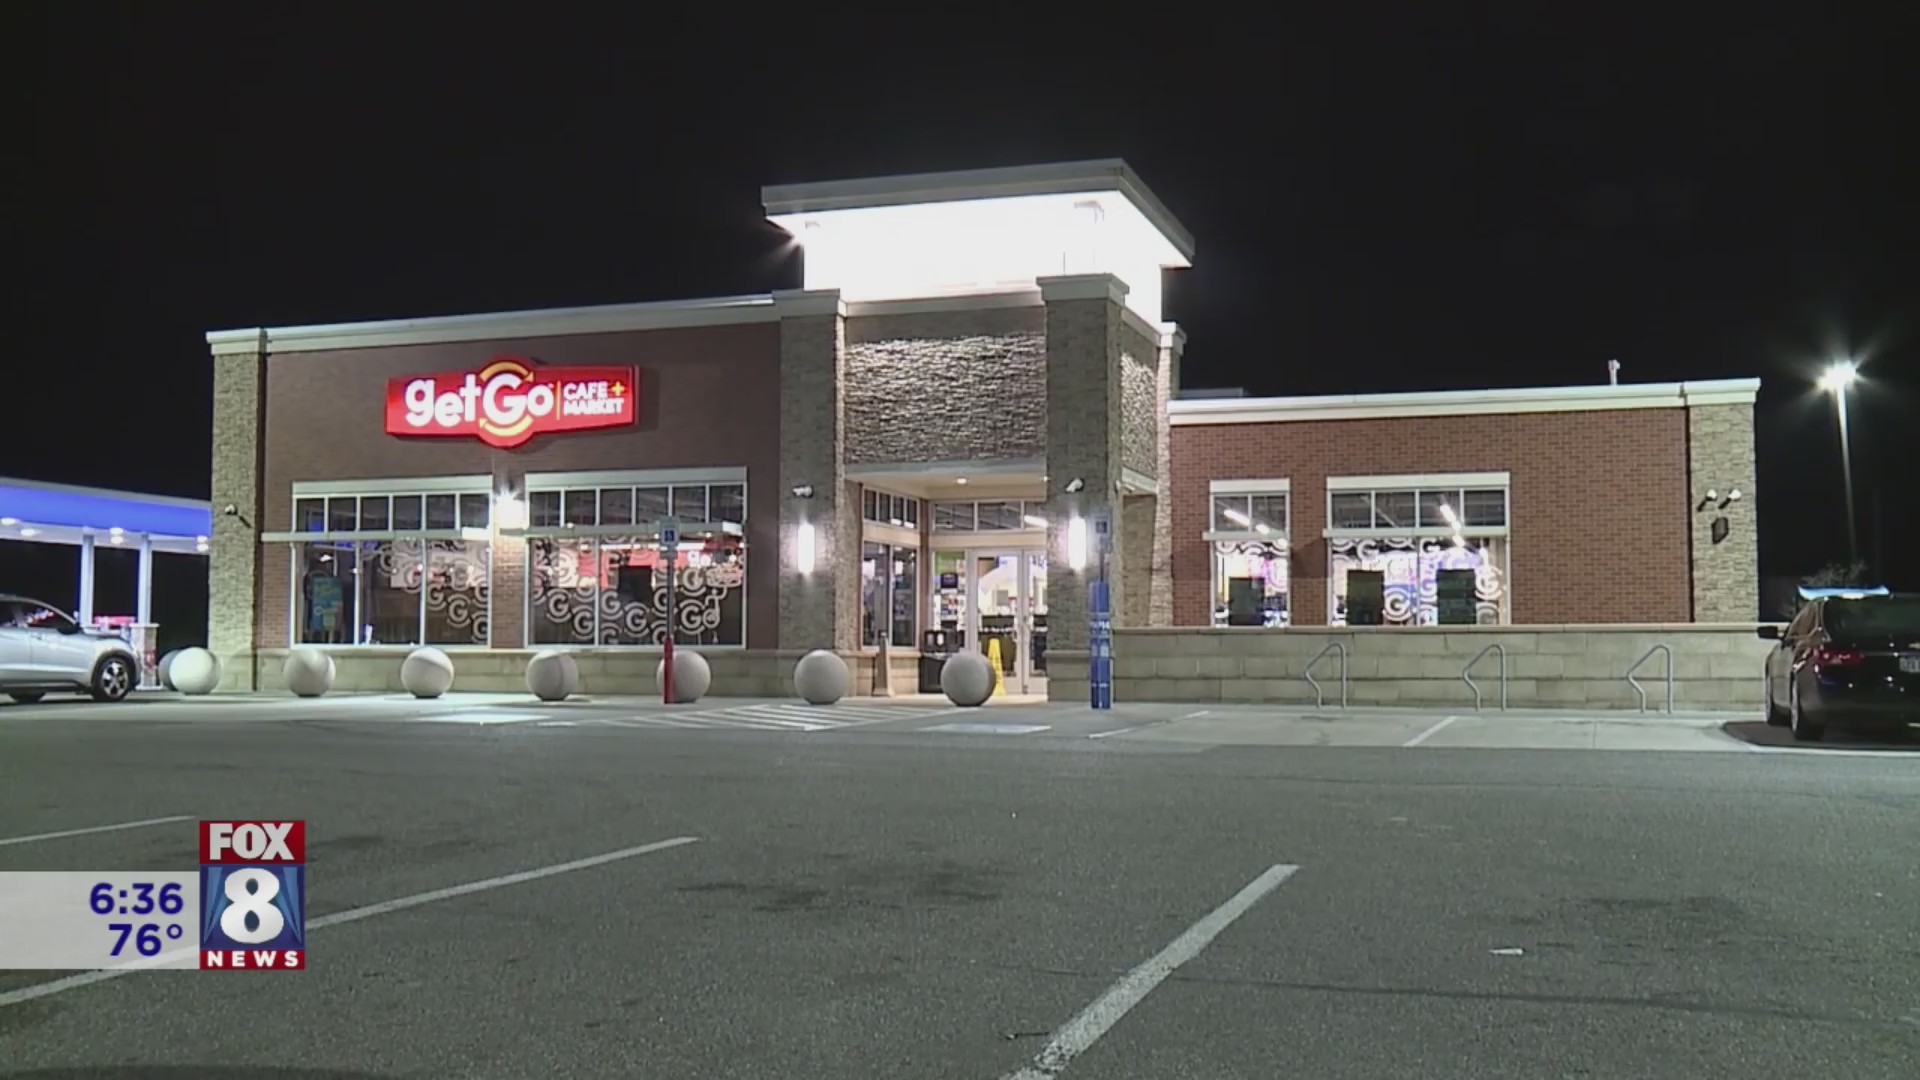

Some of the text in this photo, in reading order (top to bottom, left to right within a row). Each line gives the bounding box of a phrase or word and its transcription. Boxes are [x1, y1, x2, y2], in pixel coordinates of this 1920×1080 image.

[405, 373, 554, 427] getGo
[563, 382, 608, 400] CAFE
[563, 398, 624, 416] MARKET
